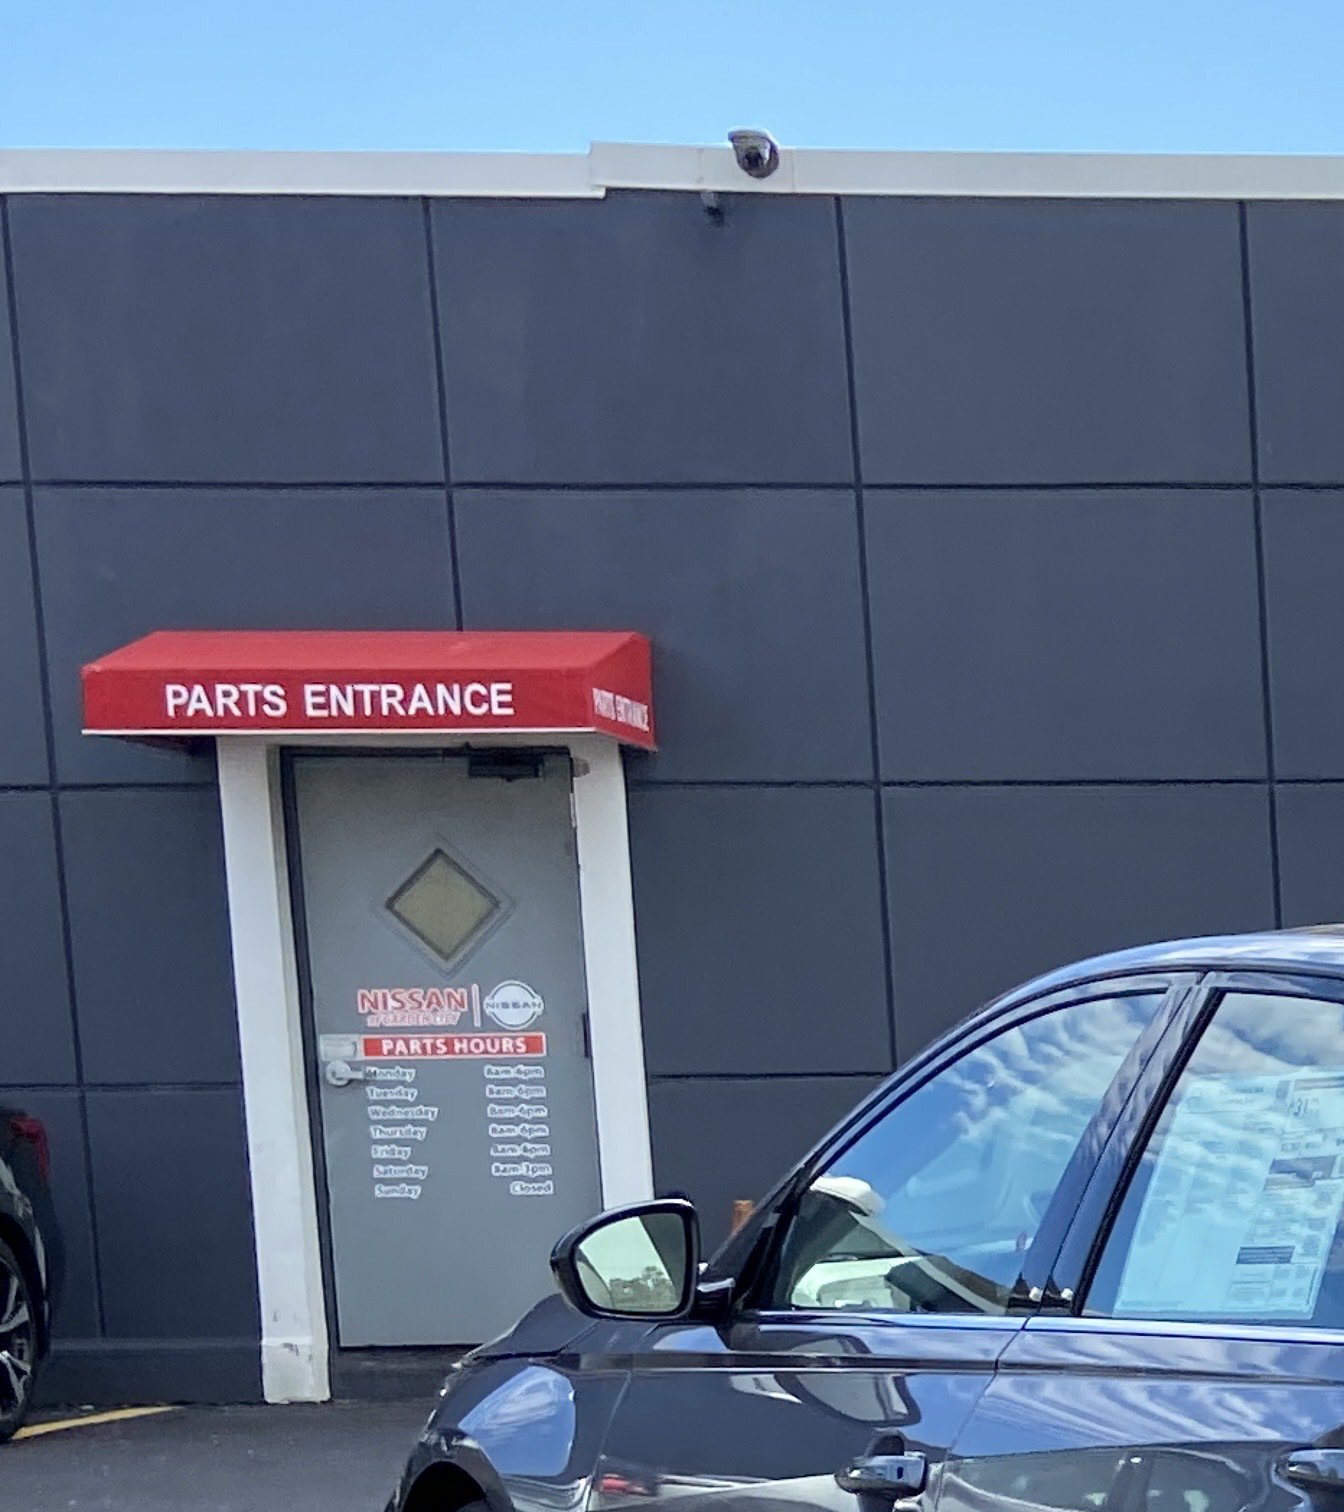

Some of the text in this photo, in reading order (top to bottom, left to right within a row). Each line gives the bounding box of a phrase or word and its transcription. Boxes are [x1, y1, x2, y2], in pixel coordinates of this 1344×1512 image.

[165, 682, 515, 717] PARTS ENTRANCE
[358, 988, 468, 1013] NISSAN
[486, 1001, 542, 1010] NISSAN
[381, 1036, 528, 1056] PARTS HOURS
[365, 1066, 416, 1082] Monday
[366, 1086, 418, 1101] Tuesday
[368, 1105, 438, 1121] Wednesday
[370, 1124, 427, 1140] Thursday
[373, 1164, 428, 1180] Saturday
[375, 1180, 554, 1199] Sunday Closed
